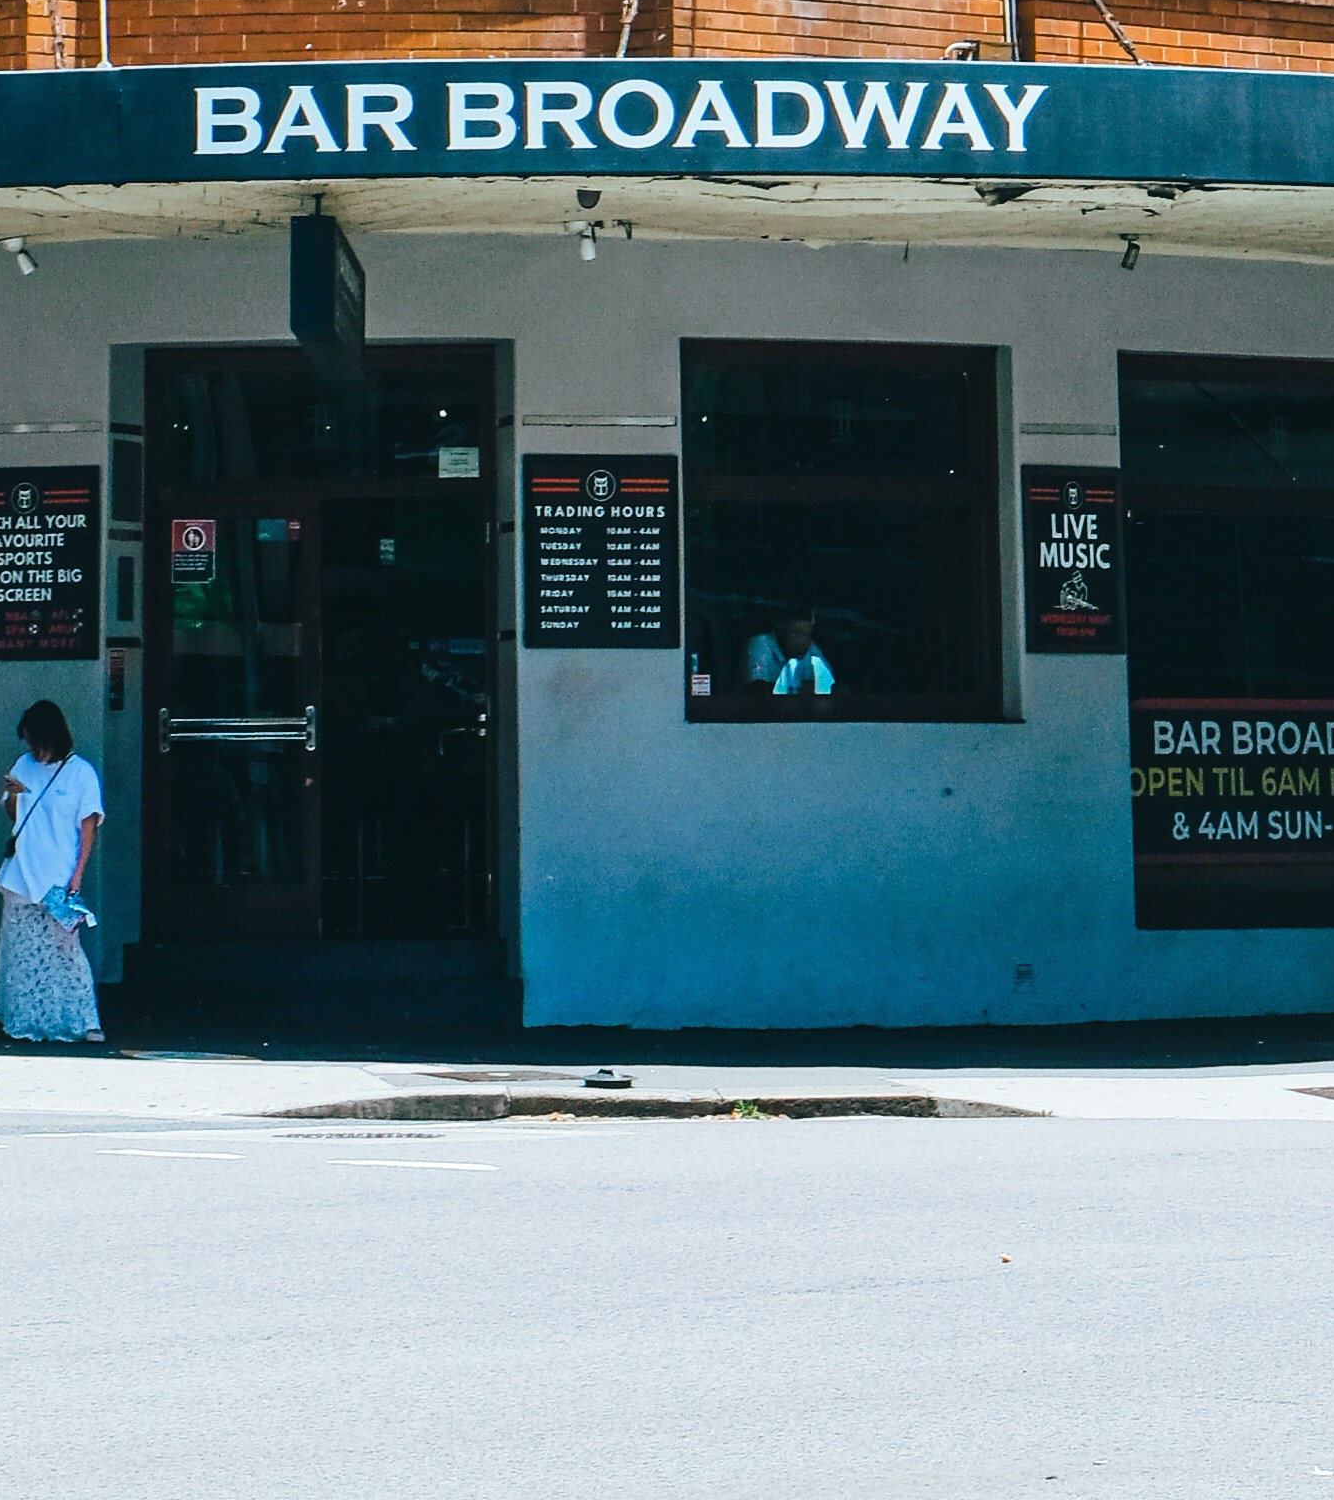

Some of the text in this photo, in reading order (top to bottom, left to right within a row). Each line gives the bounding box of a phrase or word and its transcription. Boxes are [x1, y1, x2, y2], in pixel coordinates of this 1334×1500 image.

[193, 78, 1049, 156] BAR BROADWAY
[15, 516, 41, 529] ALL
[45, 514, 87, 528] YOUR
[534, 505, 666, 518] TRADING HOURS
[1051, 513, 1098, 539] LIVE
[1039, 542, 1111, 569] MUSIC
[0, 570, 23, 584] ON
[27, 569, 53, 583] THE
[57, 568, 83, 583] BIG
[1153, 720, 1221, 755] BAR
[1130, 767, 1204, 797] OPEN
[1212, 767, 1254, 797] TIL
[1262, 767, 1320, 797] 6AM
[1172, 811, 1190, 841] &
[1198, 810, 1259, 840] 4AM
[1268, 810, 1333, 840] SUN-
